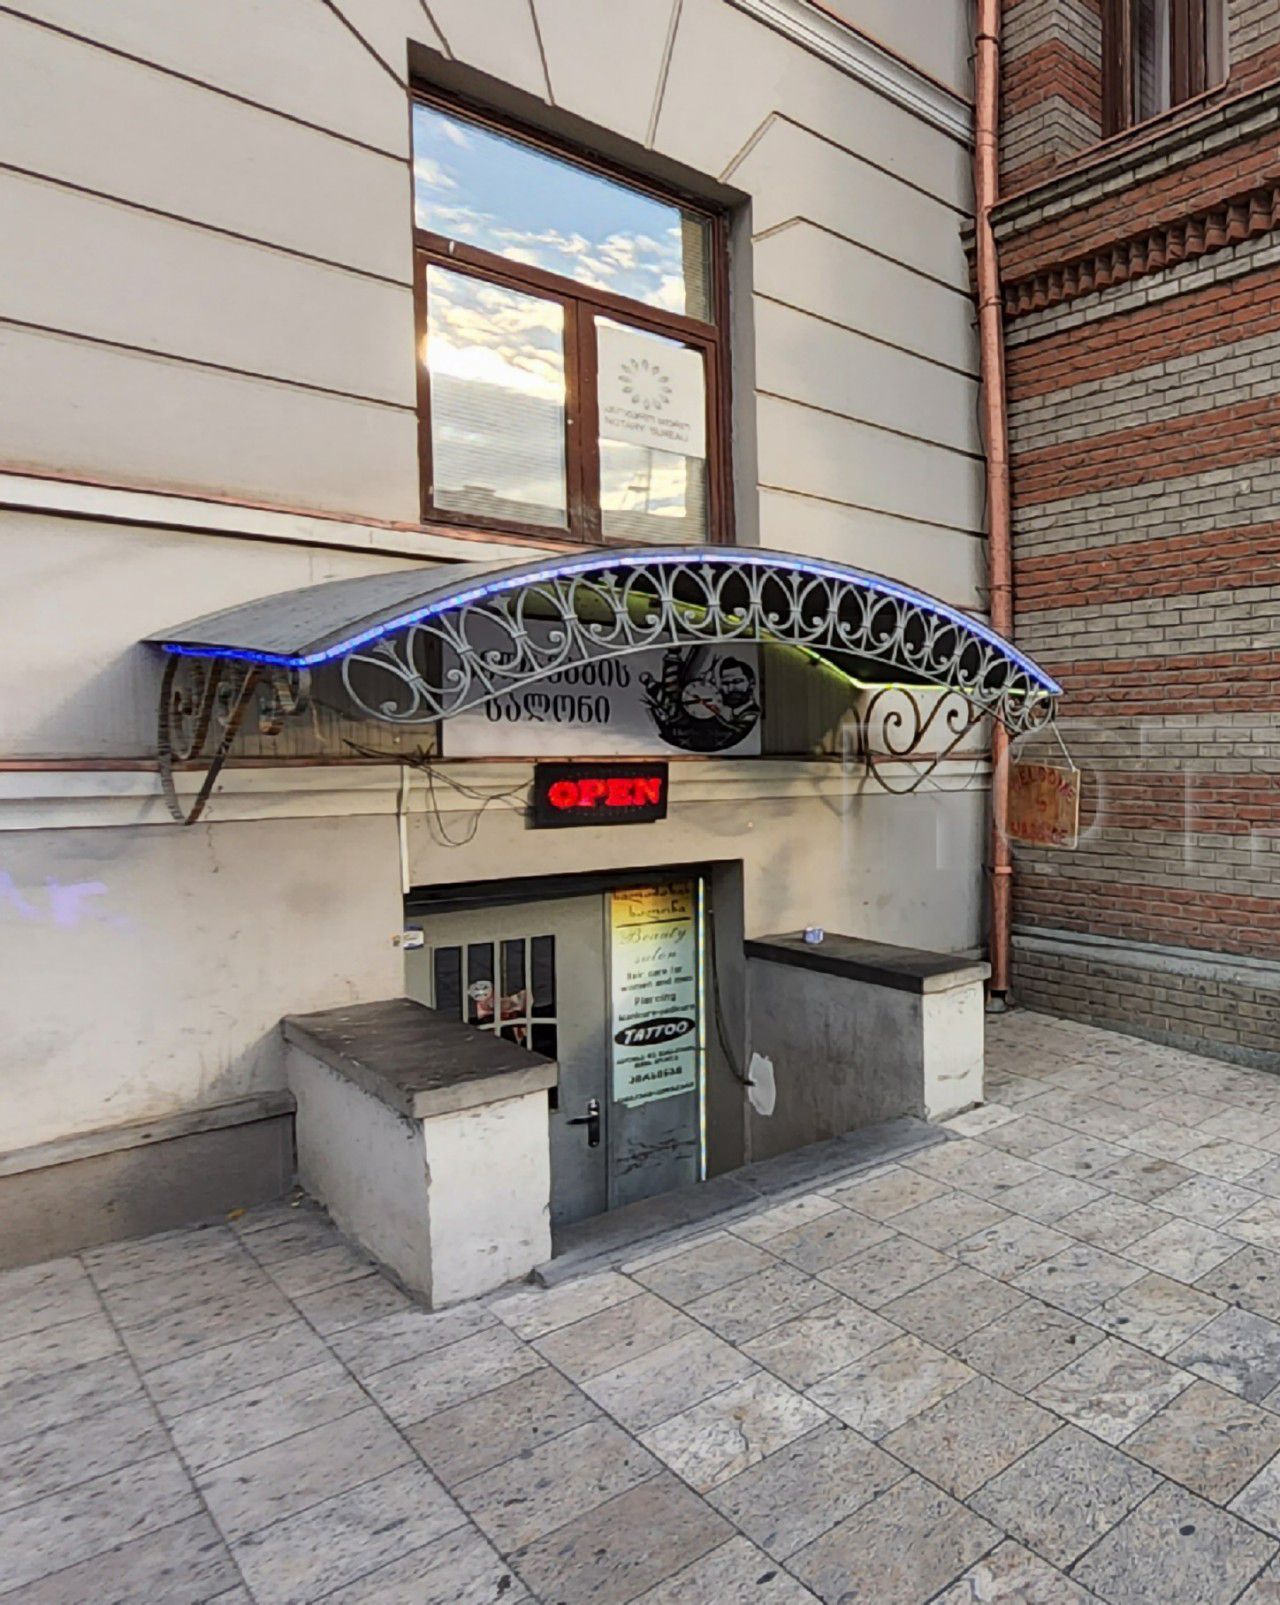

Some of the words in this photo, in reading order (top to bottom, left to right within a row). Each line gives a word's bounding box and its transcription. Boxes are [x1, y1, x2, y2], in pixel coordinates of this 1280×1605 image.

[485, 691, 611, 723] სალონი
[548, 777, 662, 808] OPEN
[624, 1020, 688, 1045] TATTOO
